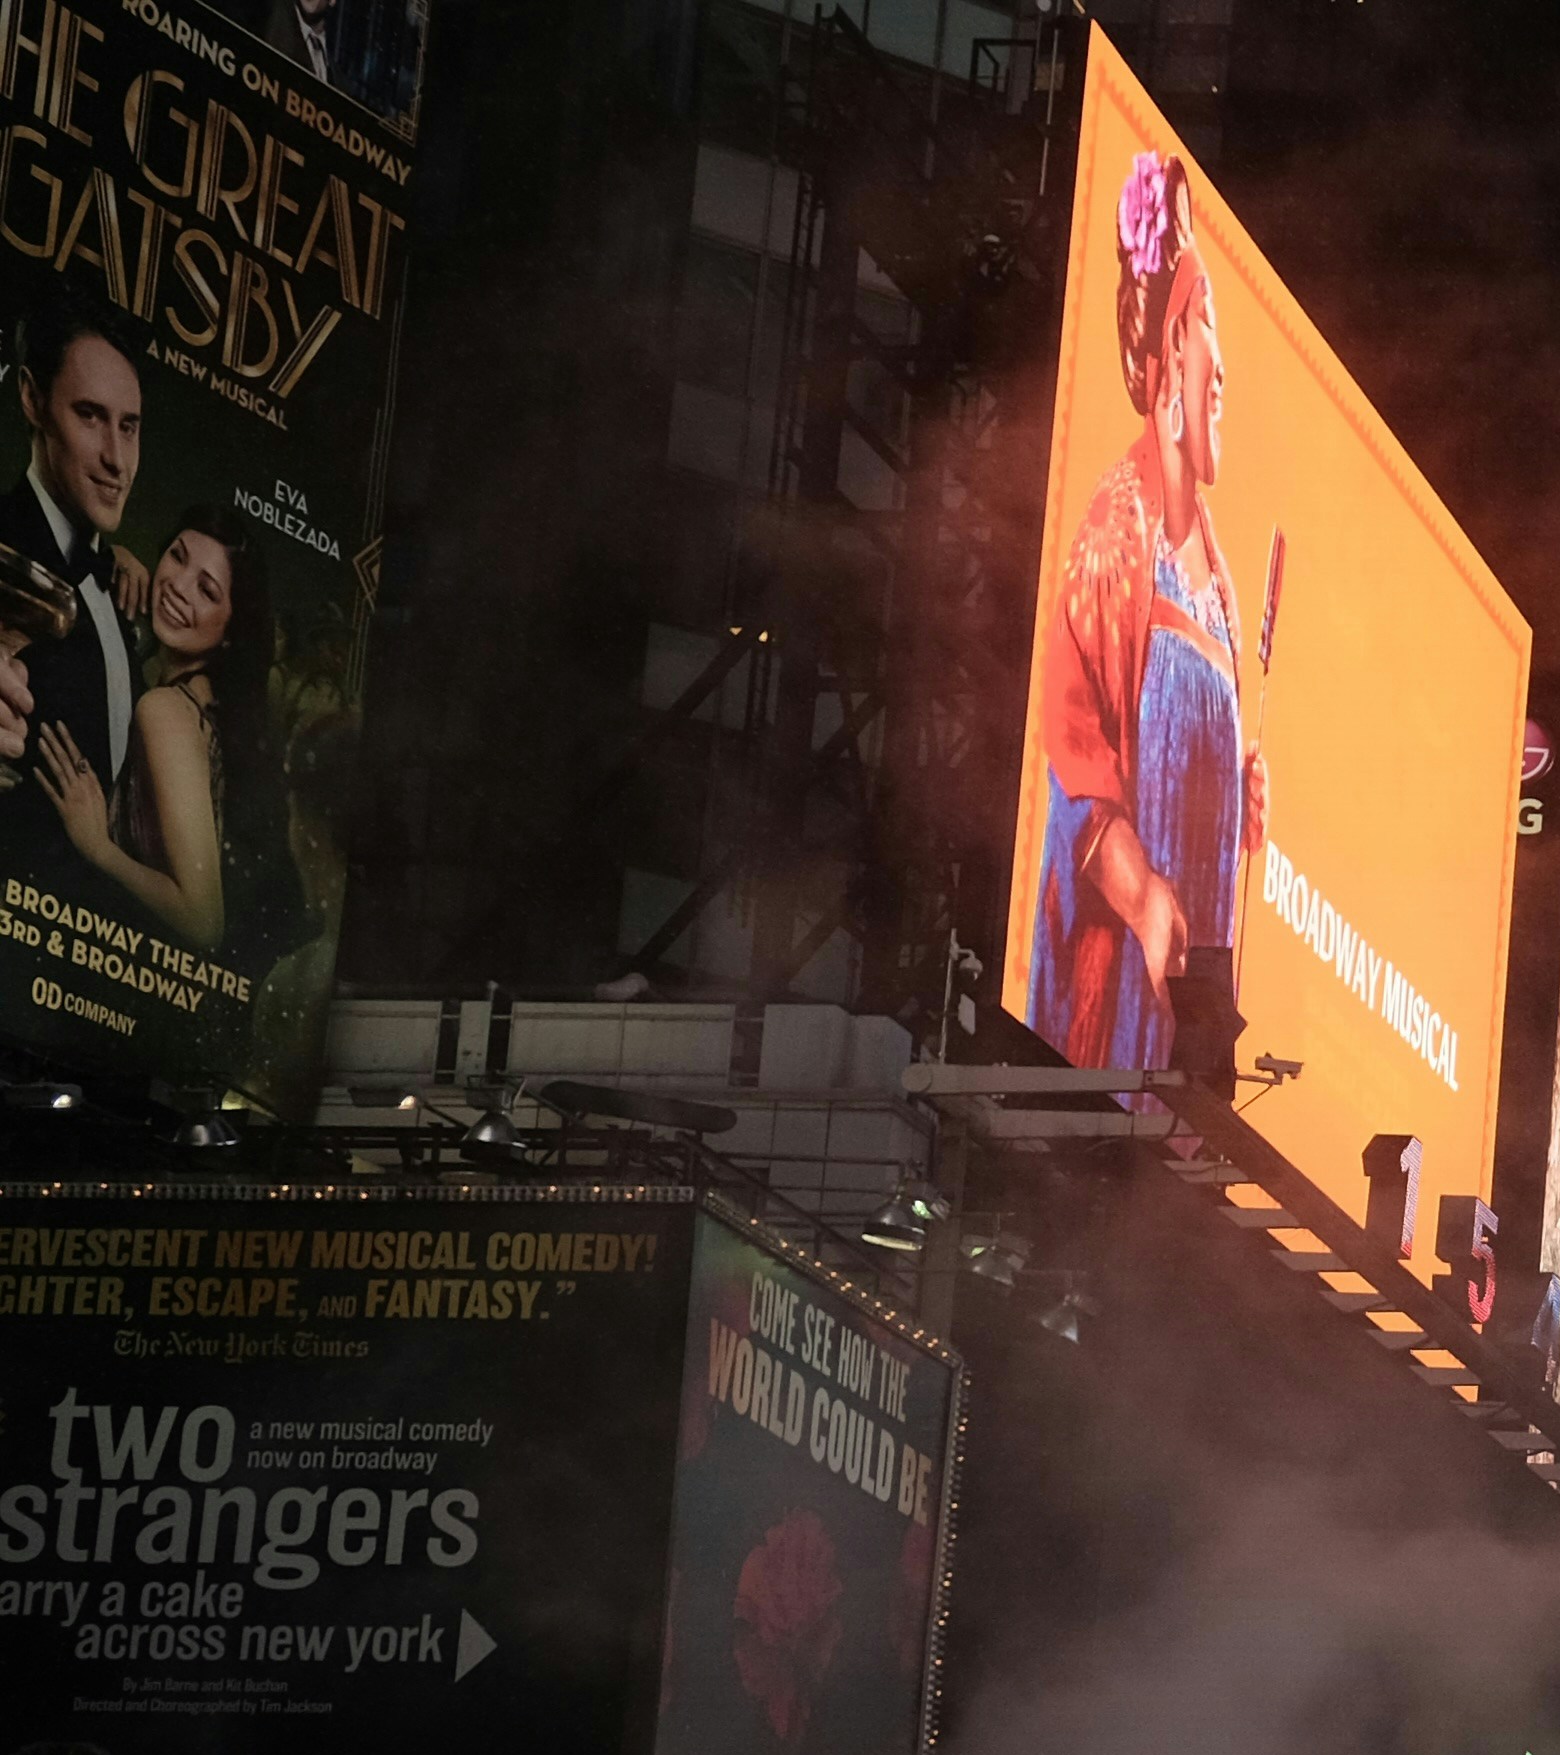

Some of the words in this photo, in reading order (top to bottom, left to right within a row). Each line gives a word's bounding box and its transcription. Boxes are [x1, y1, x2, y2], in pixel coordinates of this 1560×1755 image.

[123, 0, 237, 77] ROARING
[241, 63, 279, 104] ON
[286, 88, 412, 186] BROADWAY
[124, 69, 406, 320] GREAT
[0, 124, 343, 399] GATSBY
[147, 345, 160, 359] A
[164, 346, 208, 382] NEW
[210, 374, 288, 432] MUSICAL
[234, 486, 342, 562] NOBLEZADA
[275, 479, 309, 516] EVA
[6, 878, 144, 955] BROADWAY
[149, 938, 253, 1003] THEATRE
[46, 930, 65, 958] &
[71, 939, 204, 1014] BROADWAY
[1263, 839, 1383, 1011] BROADWAY
[1381, 960, 1459, 1092] MUSICAL
[63, 991, 137, 1037] COMPANY
[214, 1230, 304, 1270] NEW
[310, 1230, 476, 1271] MUSICAL
[485, 1231, 658, 1272] COMEDY!
[148, 1276, 308, 1322] ESCAPE,
[316, 1295, 357, 1319] AND
[114, 1328, 161, 1359] The
[164, 1329, 218, 1358] New
[225, 1330, 288, 1364] York
[291, 1330, 370, 1359] Times
[749, 1271, 799, 1355] COME
[802, 1303, 835, 1377] SEE
[837, 1326, 875, 1400] HOW
[878, 1351, 910, 1423] THE
[48, 1386, 236, 1484] two
[247, 1450, 294, 1469] now
[299, 1450, 326, 1469] on
[331, 1446, 437, 1475] broadway
[249, 1421, 263, 1440] a
[269, 1421, 315, 1440] new
[320, 1416, 404, 1441] musical
[409, 1417, 494, 1447] comedy
[708, 1318, 806, 1447] WORLD
[810, 1387, 895, 1502] COULD
[898, 1443, 933, 1527] BE
[0, 1476, 480, 1590] strangers
[101, 1580, 126, 1618] a
[140, 1570, 245, 1619] cake
[74, 1622, 226, 1662] across
[239, 1624, 336, 1662] new
[344, 1614, 445, 1674] york
[125, 1699, 148, 1712] and
[243, 1698, 257, 1714] by
[284, 1700, 333, 1714] Jackson
[201, 1678, 225, 1692] and
